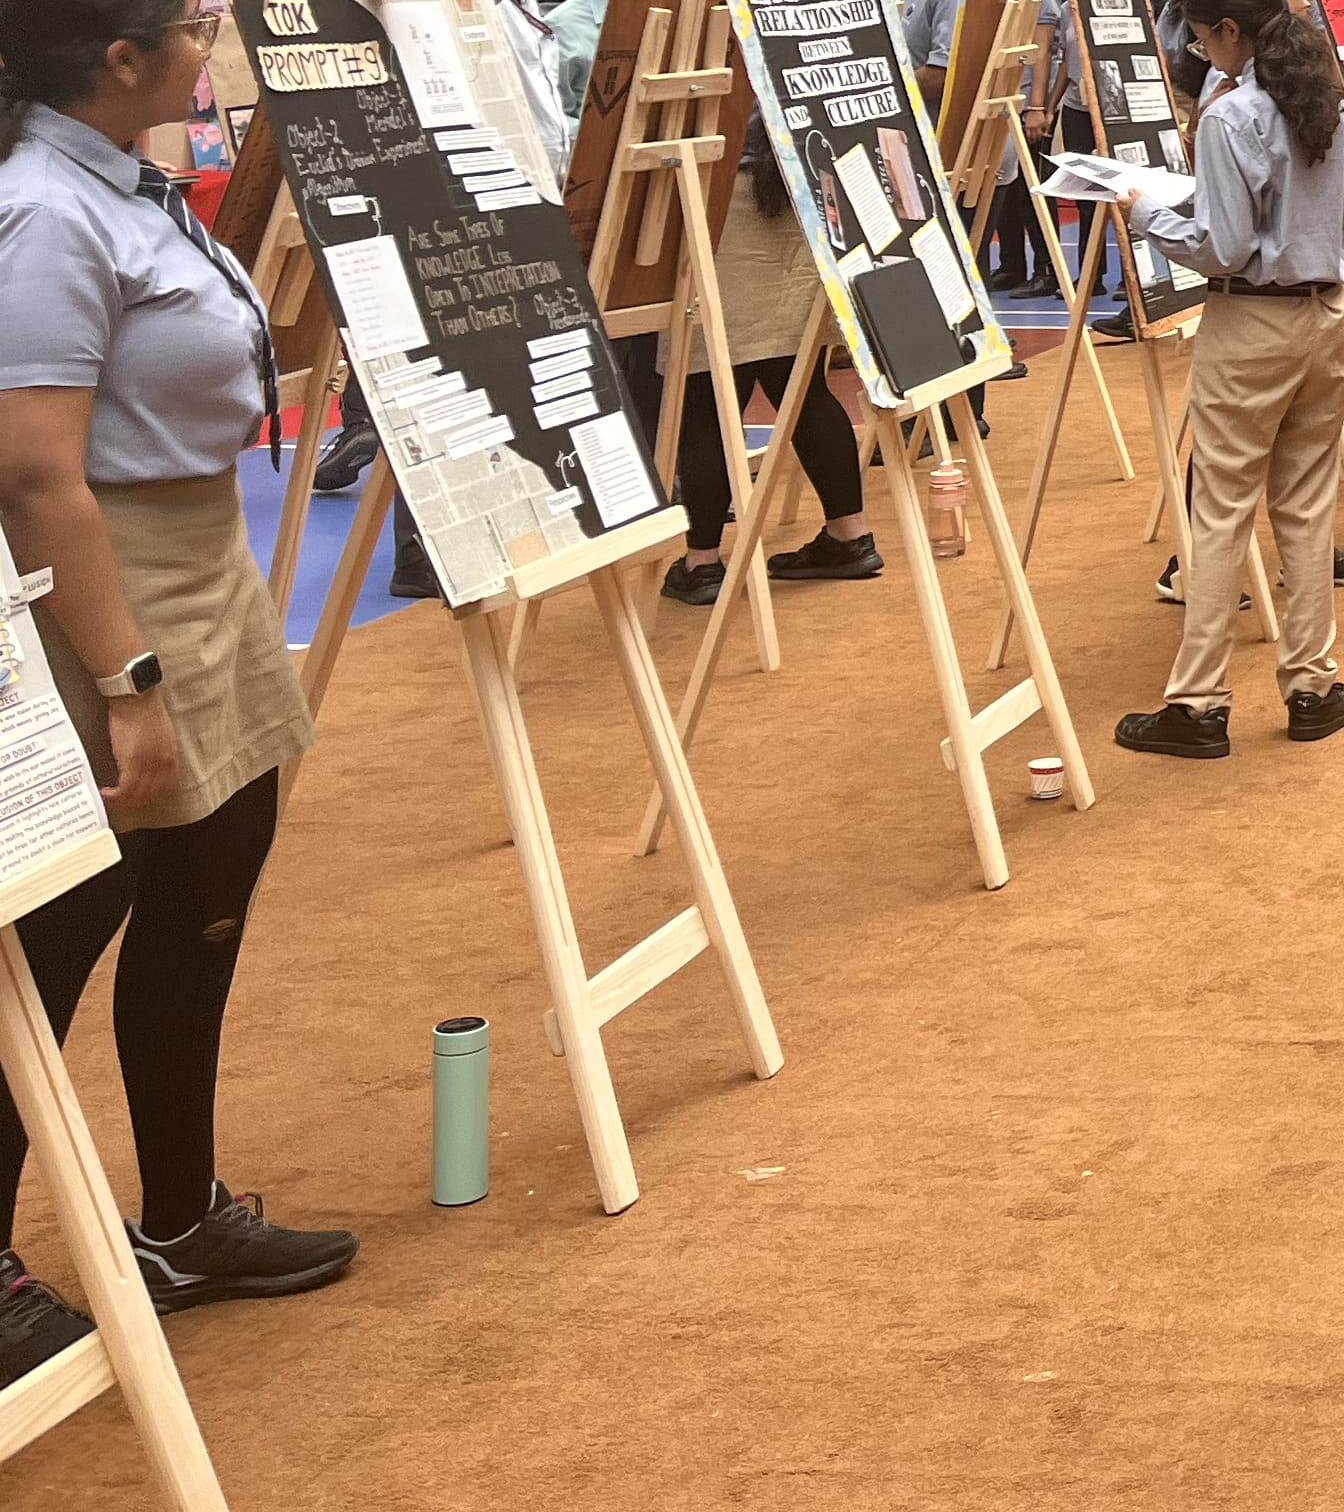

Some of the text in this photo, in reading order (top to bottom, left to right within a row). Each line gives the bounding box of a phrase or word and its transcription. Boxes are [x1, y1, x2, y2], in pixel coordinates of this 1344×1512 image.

[268, 3, 312, 32] TOK
[757, 0, 874, 33] RELATIONSHIP
[802, 40, 851, 59] BETWEEN
[786, 61, 889, 96] KNOWLEDGE
[790, 91, 897, 124] AND CULTURE
[416, 245, 486, 280] KNOWLEDGE
[36, 785, 52, 799] THIS
[55, 771, 83, 791] OBJECT
